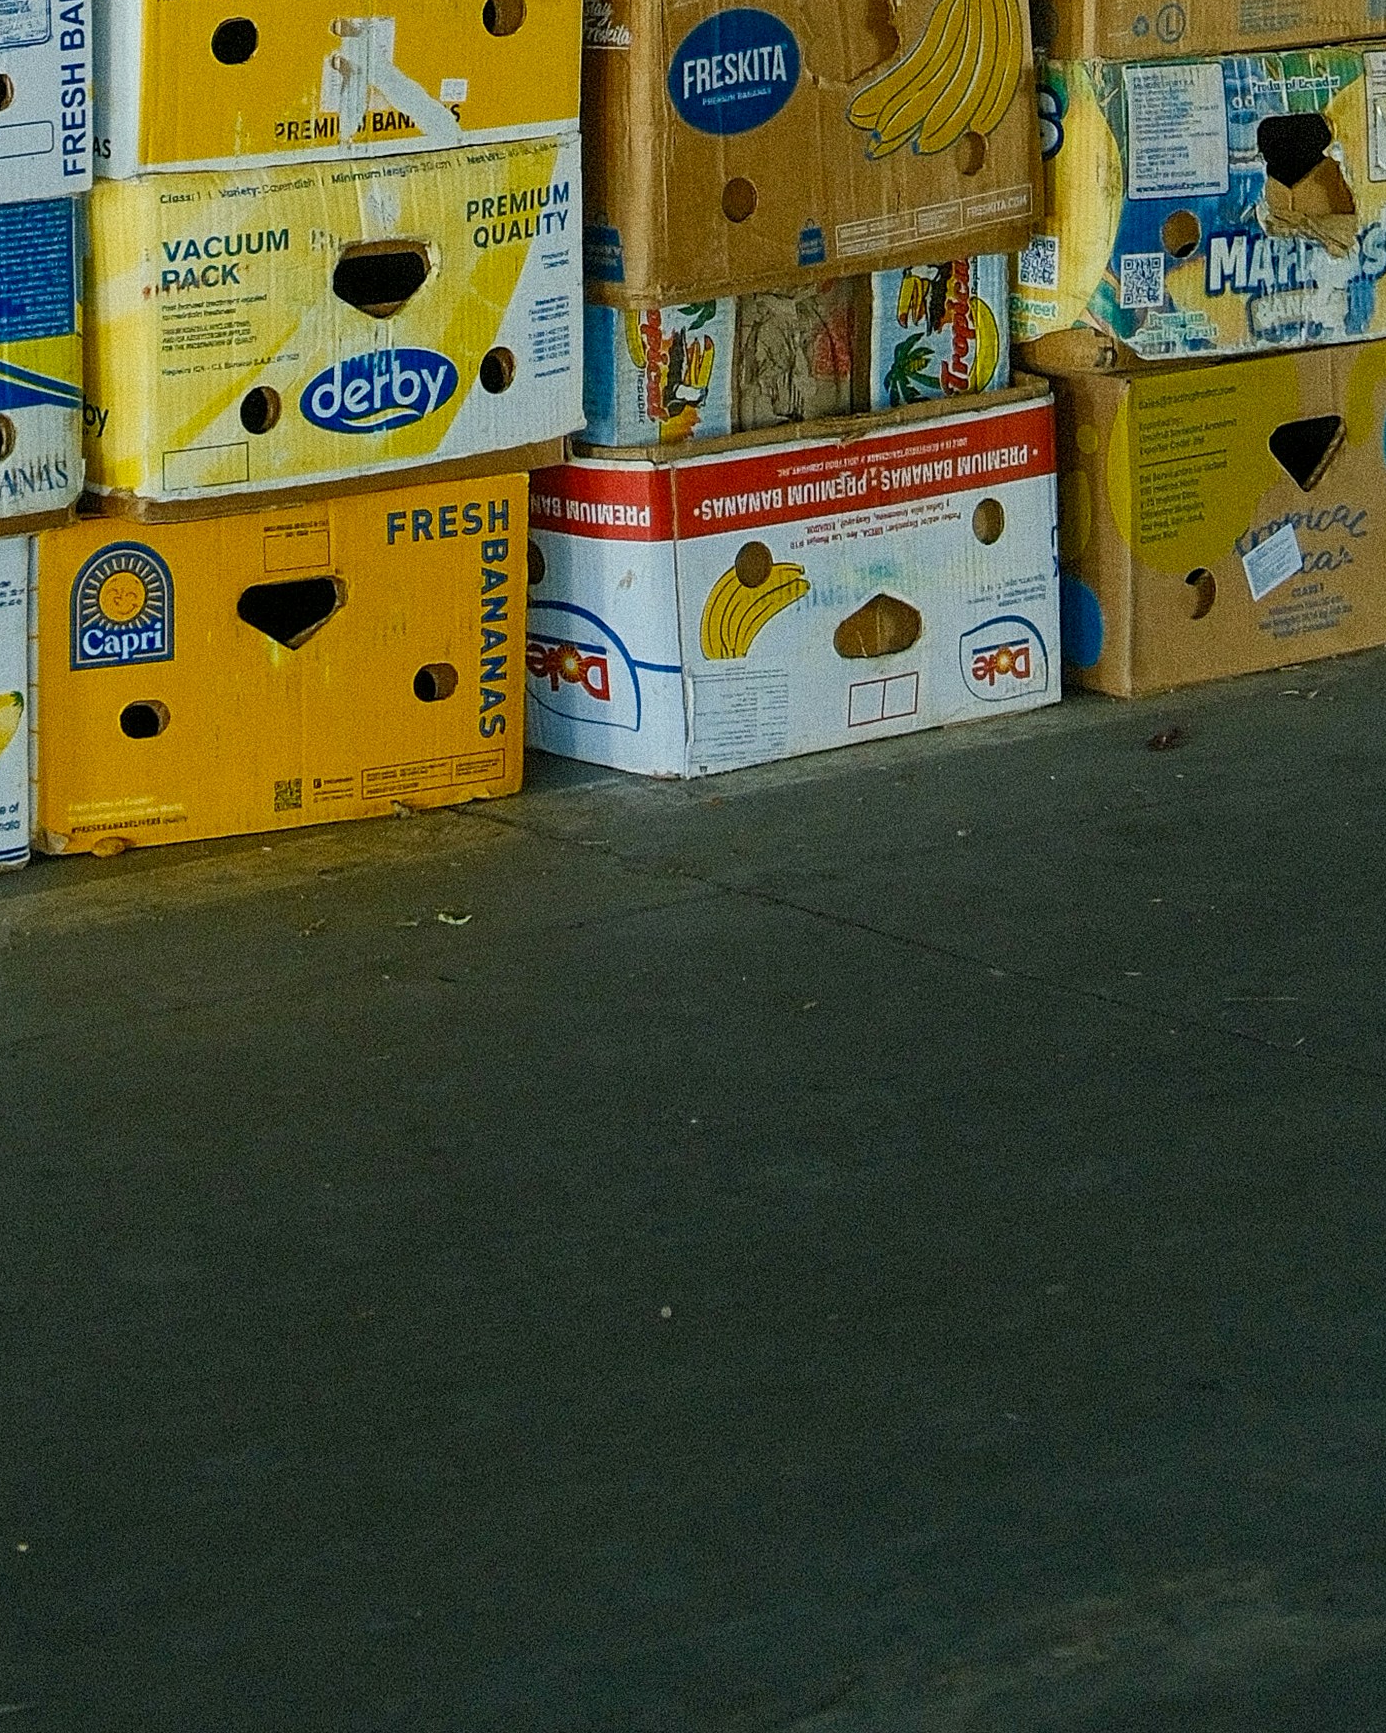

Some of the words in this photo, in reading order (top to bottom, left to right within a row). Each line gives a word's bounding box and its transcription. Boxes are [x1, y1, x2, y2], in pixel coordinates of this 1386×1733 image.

[683, 43, 787, 100] FRESKITA
[63, 64, 87, 176] FRESH
[465, 182, 570, 222] PREMIUM
[162, 229, 291, 262] VACUUM
[472, 211, 568, 250] QUALITY
[162, 262, 241, 289] PACK
[311, 357, 448, 421] derby
[385, 498, 510, 545] FRESH
[567, 507, 651, 527] PREMIUM
[81, 628, 163, 660] Capri
[477, 538, 510, 738] BANANAS
[971, 645, 1032, 680] Dole
